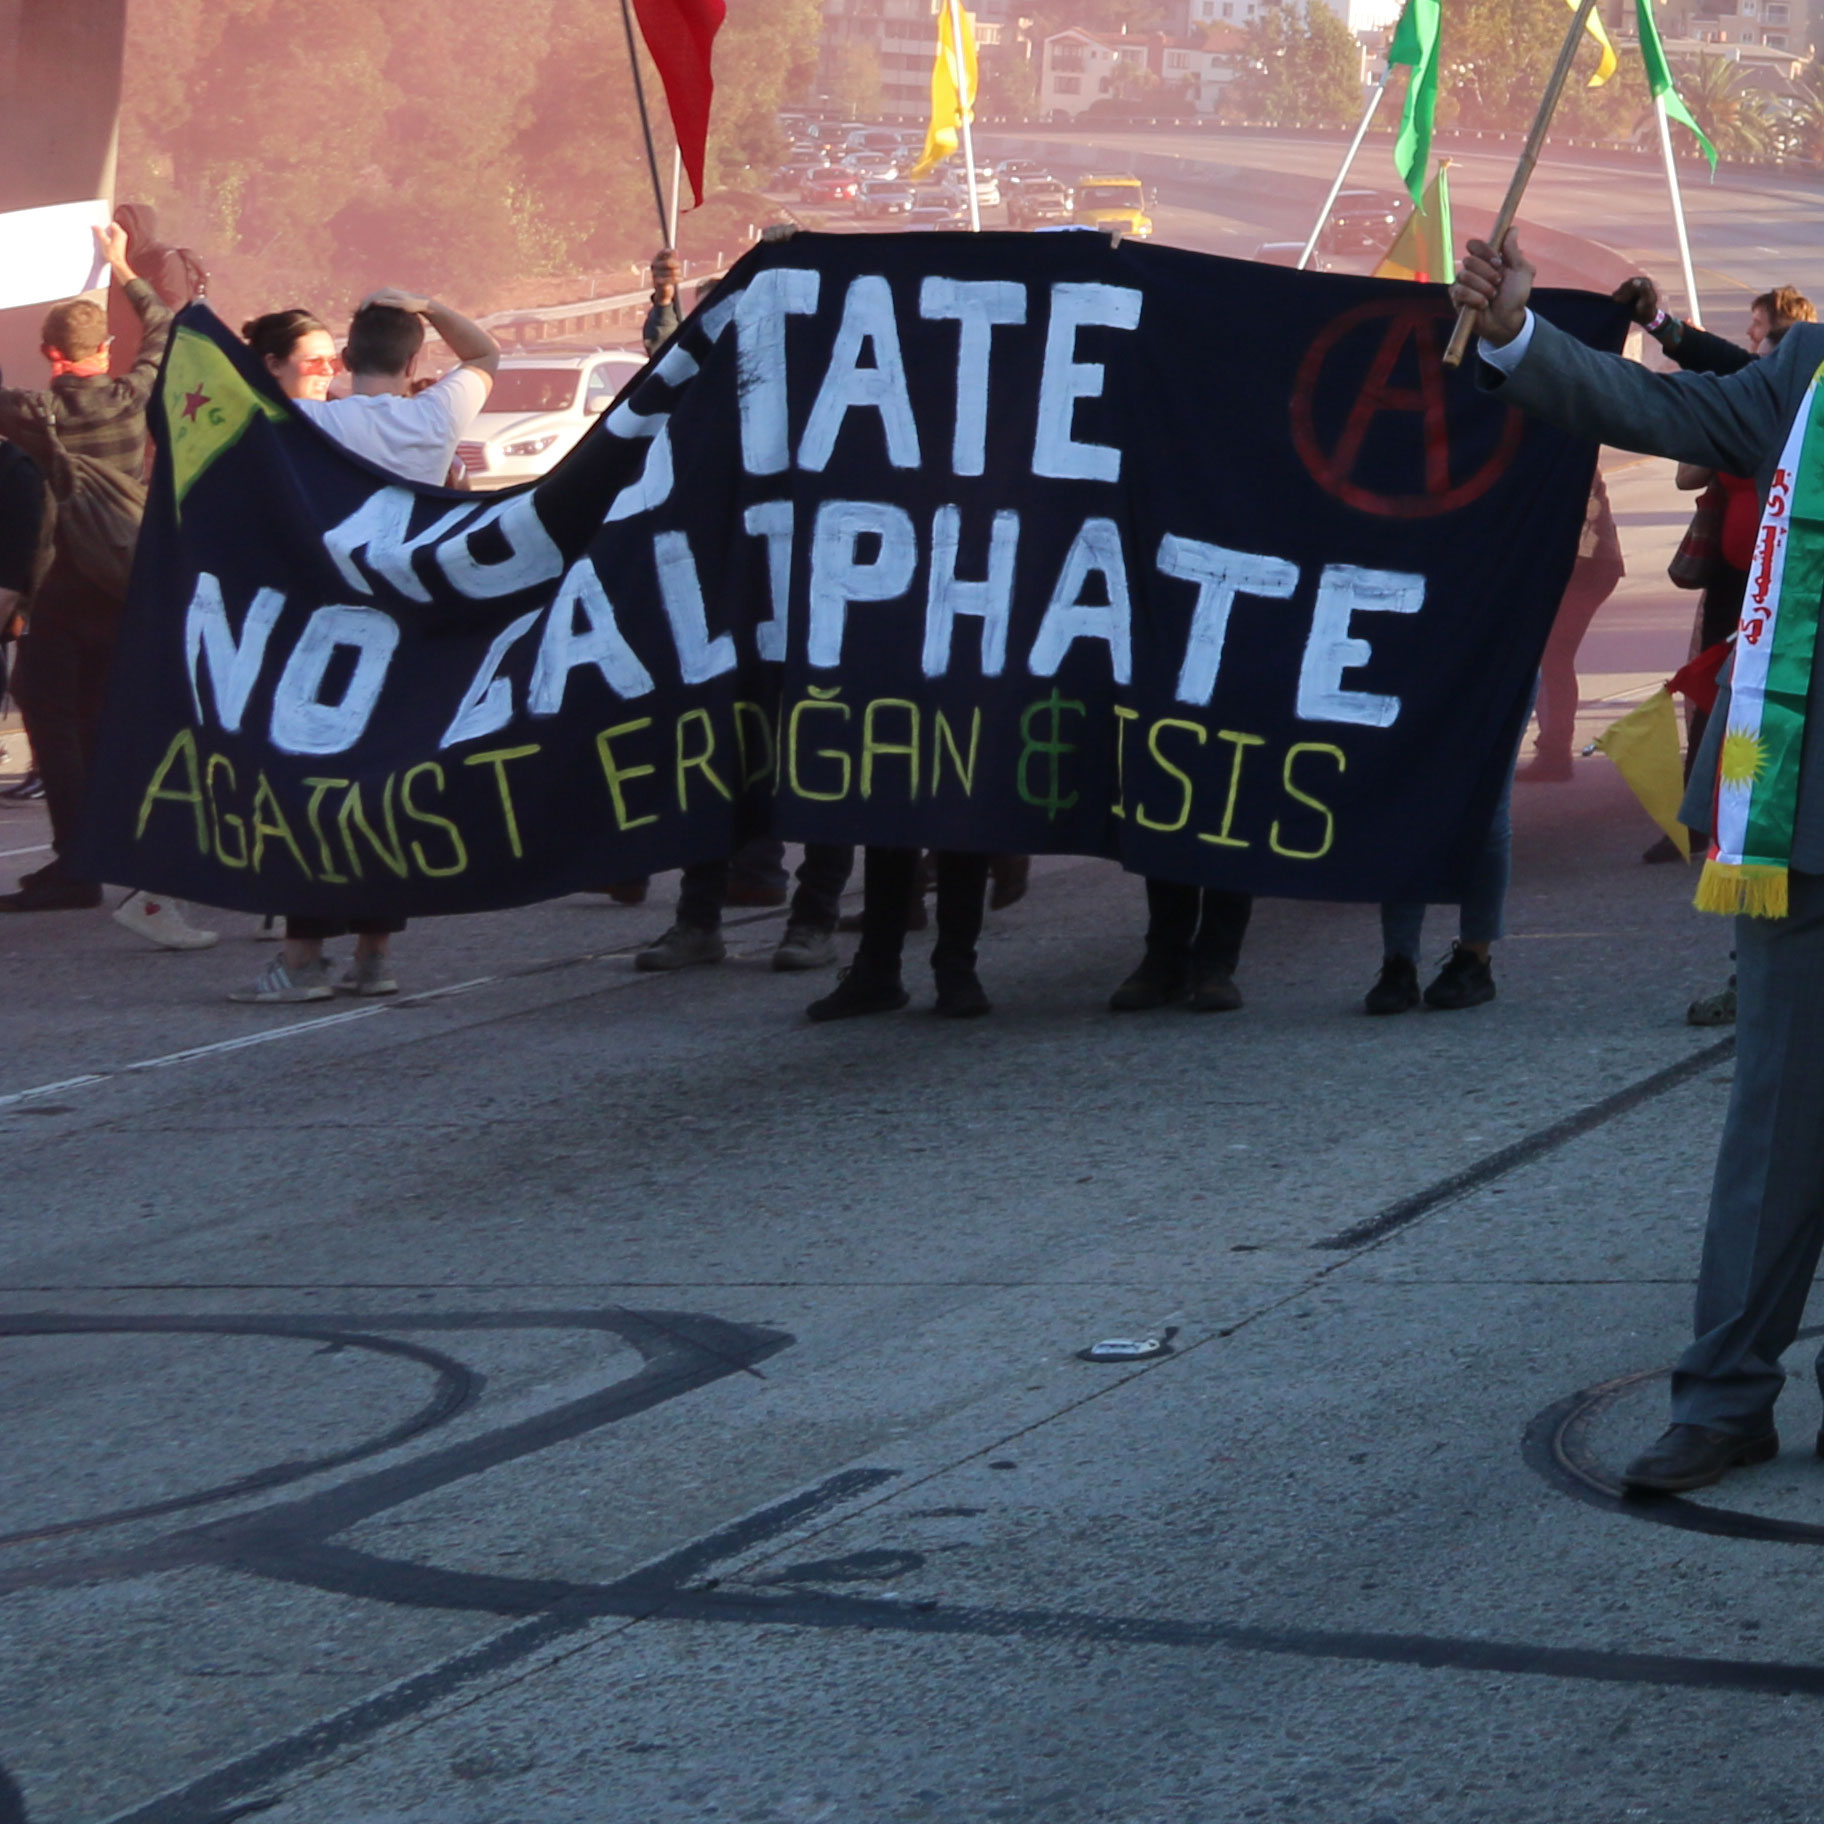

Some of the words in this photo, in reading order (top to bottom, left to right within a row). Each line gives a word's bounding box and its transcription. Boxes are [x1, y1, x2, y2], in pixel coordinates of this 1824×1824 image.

[322, 485, 565, 604] NO
[185, 571, 400, 757] NO
[136, 727, 543, 884] AGAINST
[597, 683, 982, 832] ERDĞAN
[1110, 704, 1347, 860] ISIS
